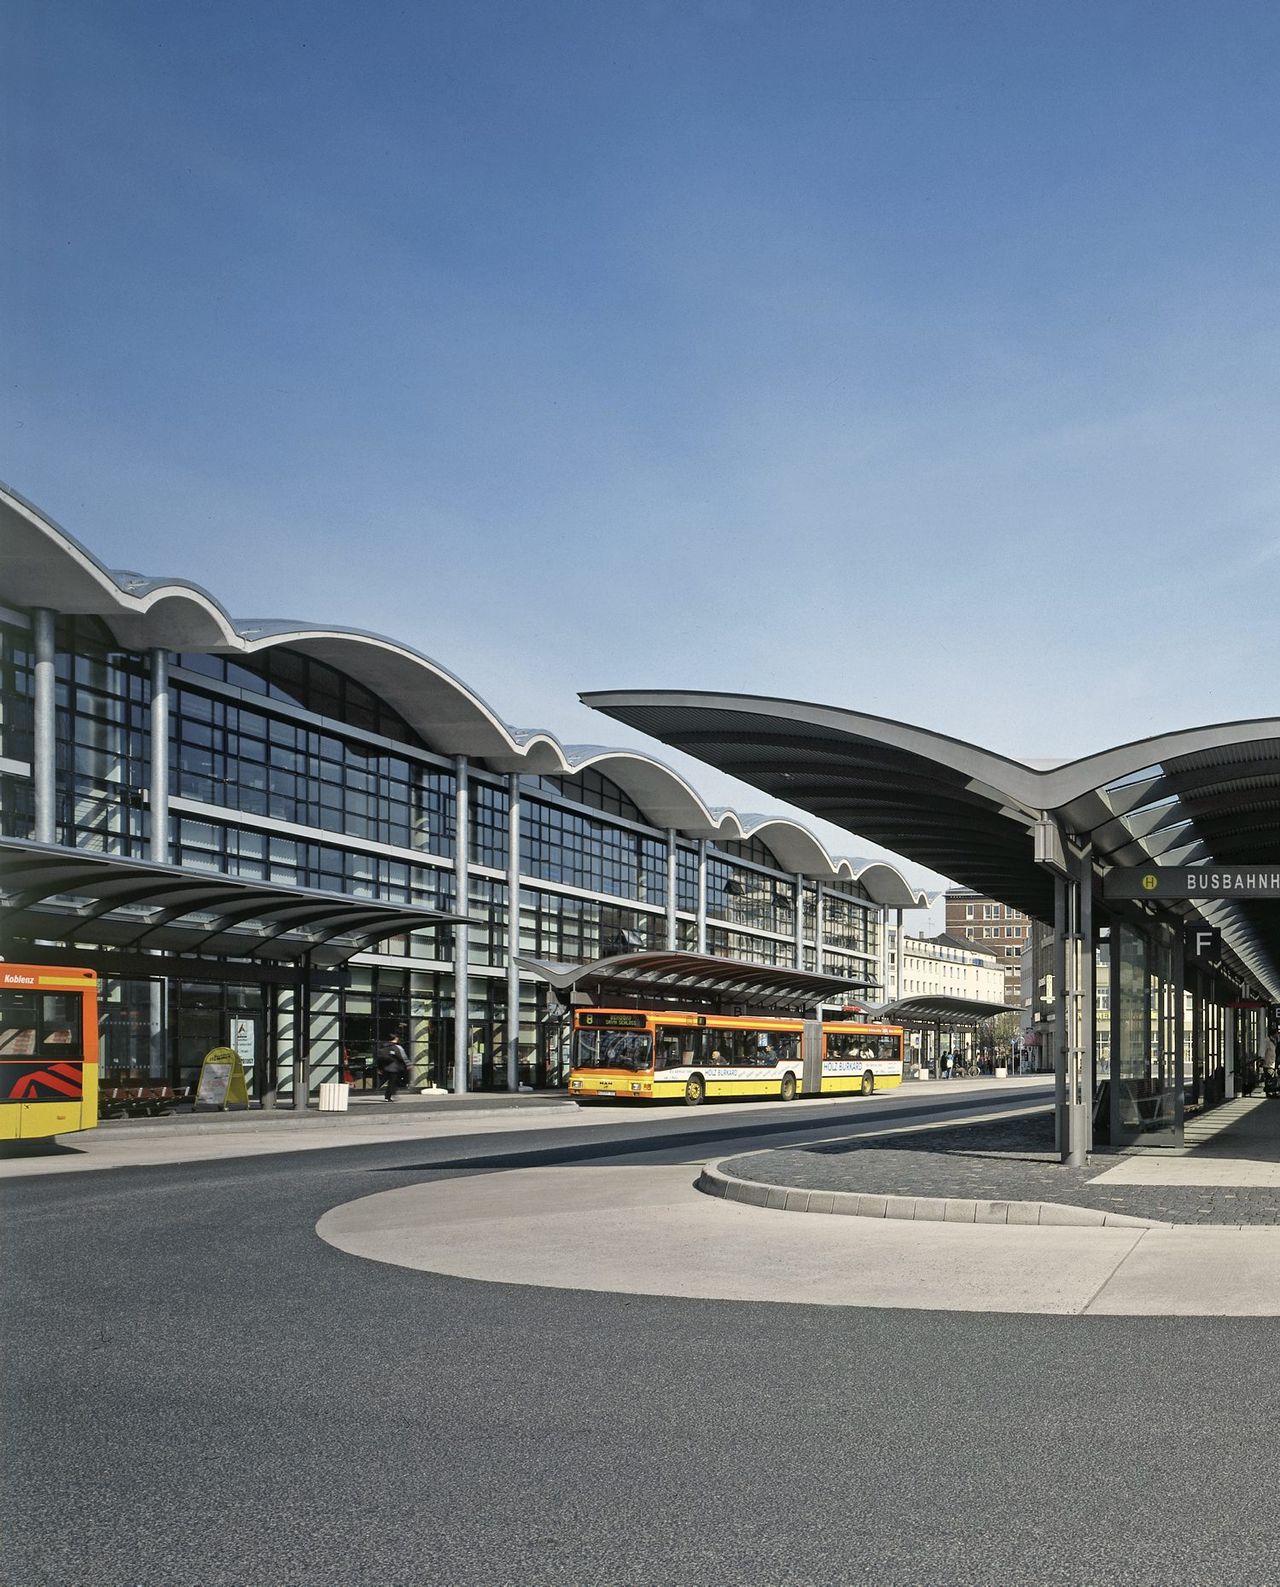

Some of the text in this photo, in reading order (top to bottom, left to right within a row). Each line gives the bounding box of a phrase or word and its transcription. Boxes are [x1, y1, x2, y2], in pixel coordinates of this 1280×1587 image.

[1196, 931, 1213, 956] F
[4, 974, 35, 984] Koblenz
[586, 1014, 593, 1025] 8
[823, 1062, 838, 1071] HOLZ
